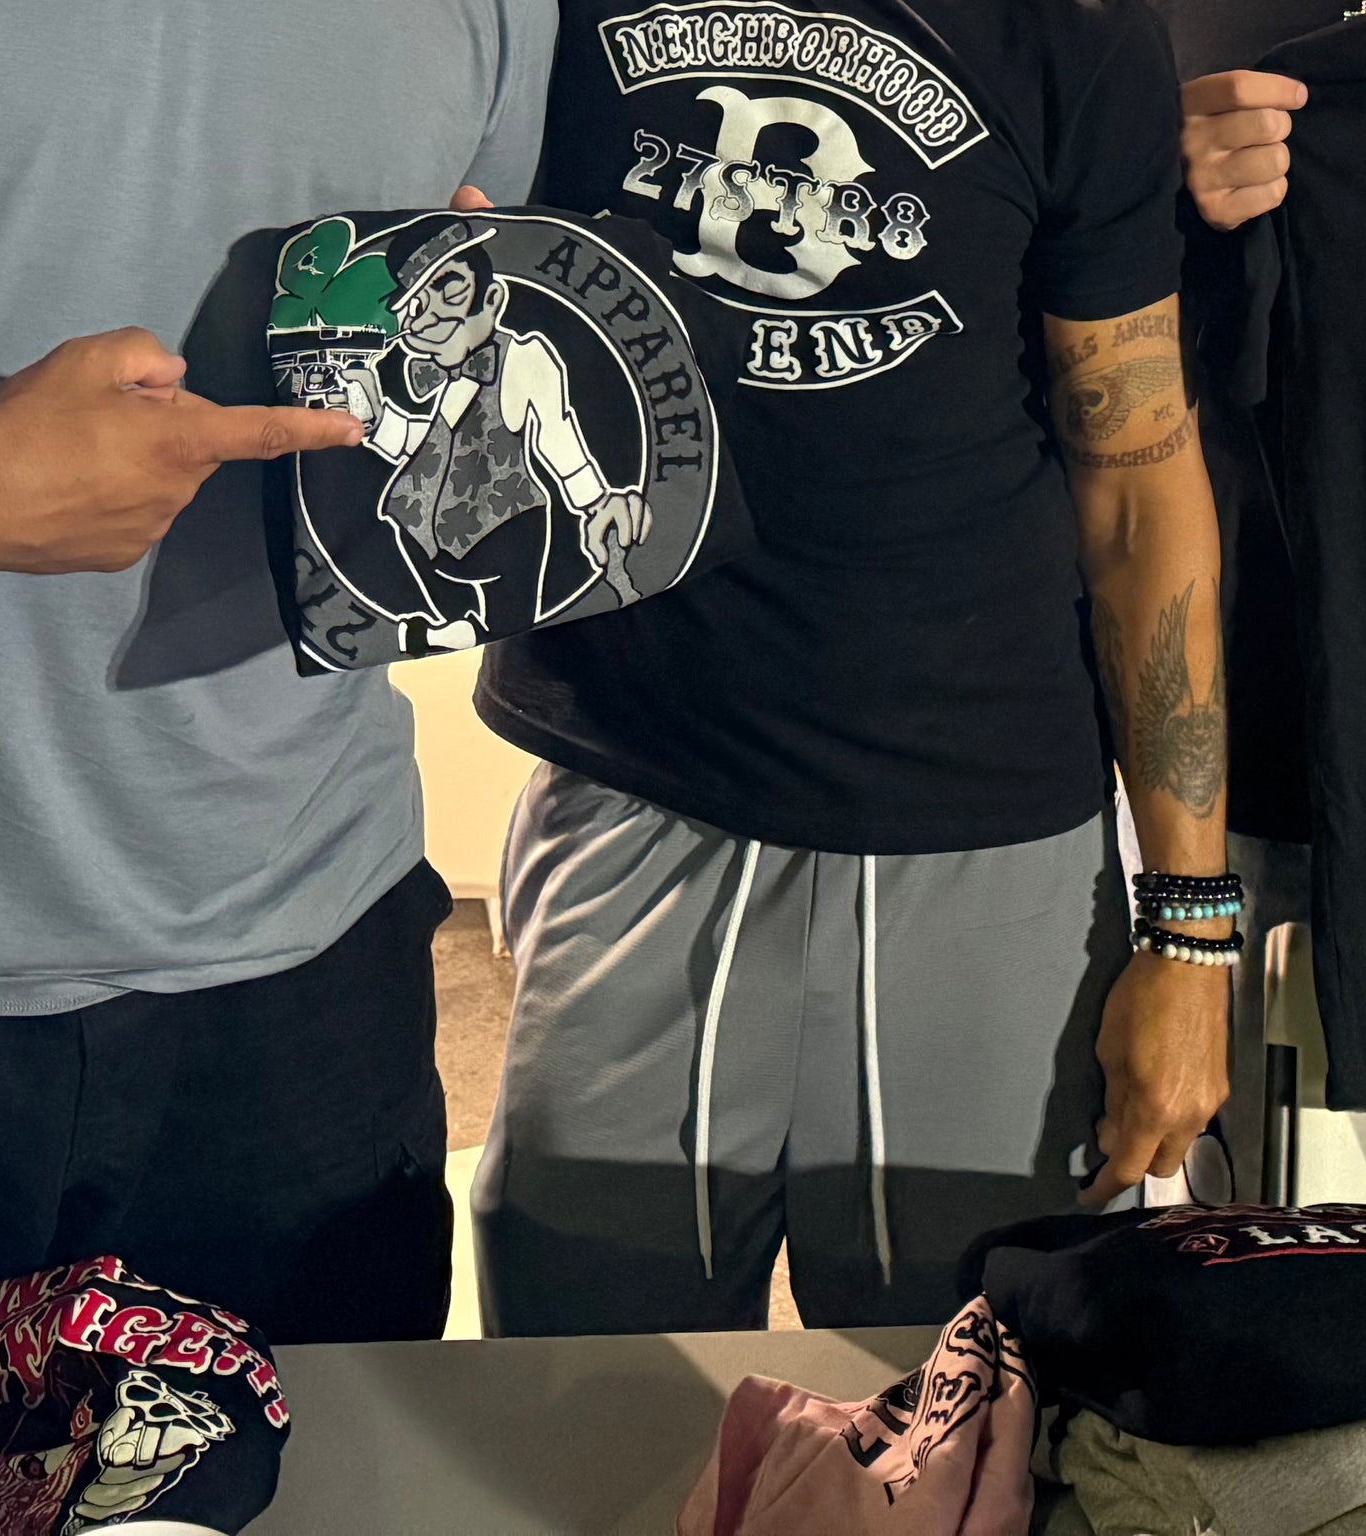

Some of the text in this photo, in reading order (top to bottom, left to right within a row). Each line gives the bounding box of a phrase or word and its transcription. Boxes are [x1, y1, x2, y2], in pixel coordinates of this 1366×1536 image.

[615, 11, 968, 147] NEIGHBORHOOD
[622, 128, 931, 261] 27STR8
[672, 85, 876, 301] B
